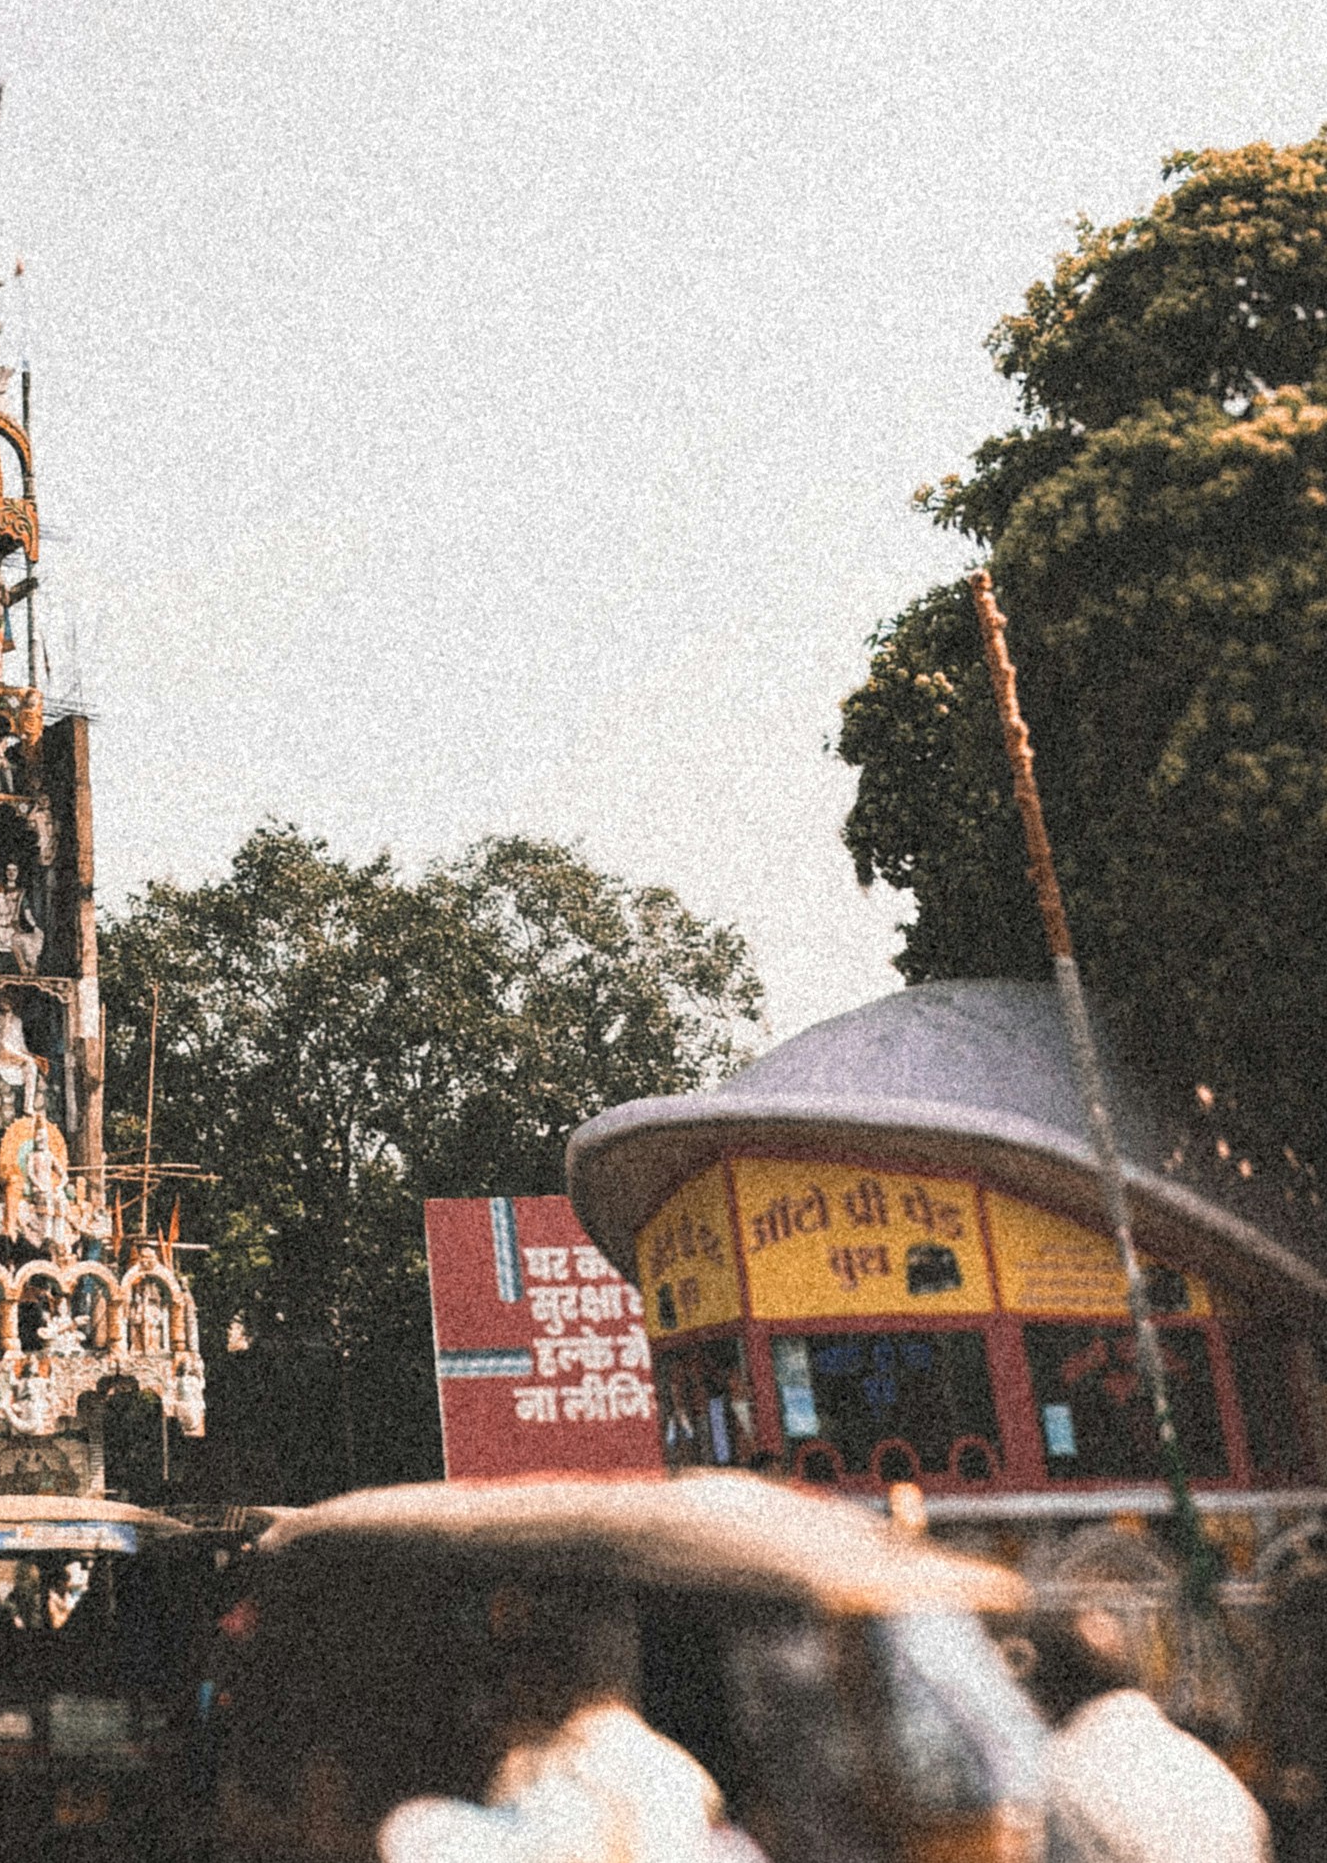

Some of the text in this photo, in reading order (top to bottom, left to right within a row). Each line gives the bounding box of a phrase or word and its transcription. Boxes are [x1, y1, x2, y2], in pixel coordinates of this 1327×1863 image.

[523, 1247, 569, 1280] घर
[527, 1285, 623, 1335] सुरक्षा
[533, 1326, 614, 1377] हल्के
[512, 1371, 654, 1422] ना लीजि
